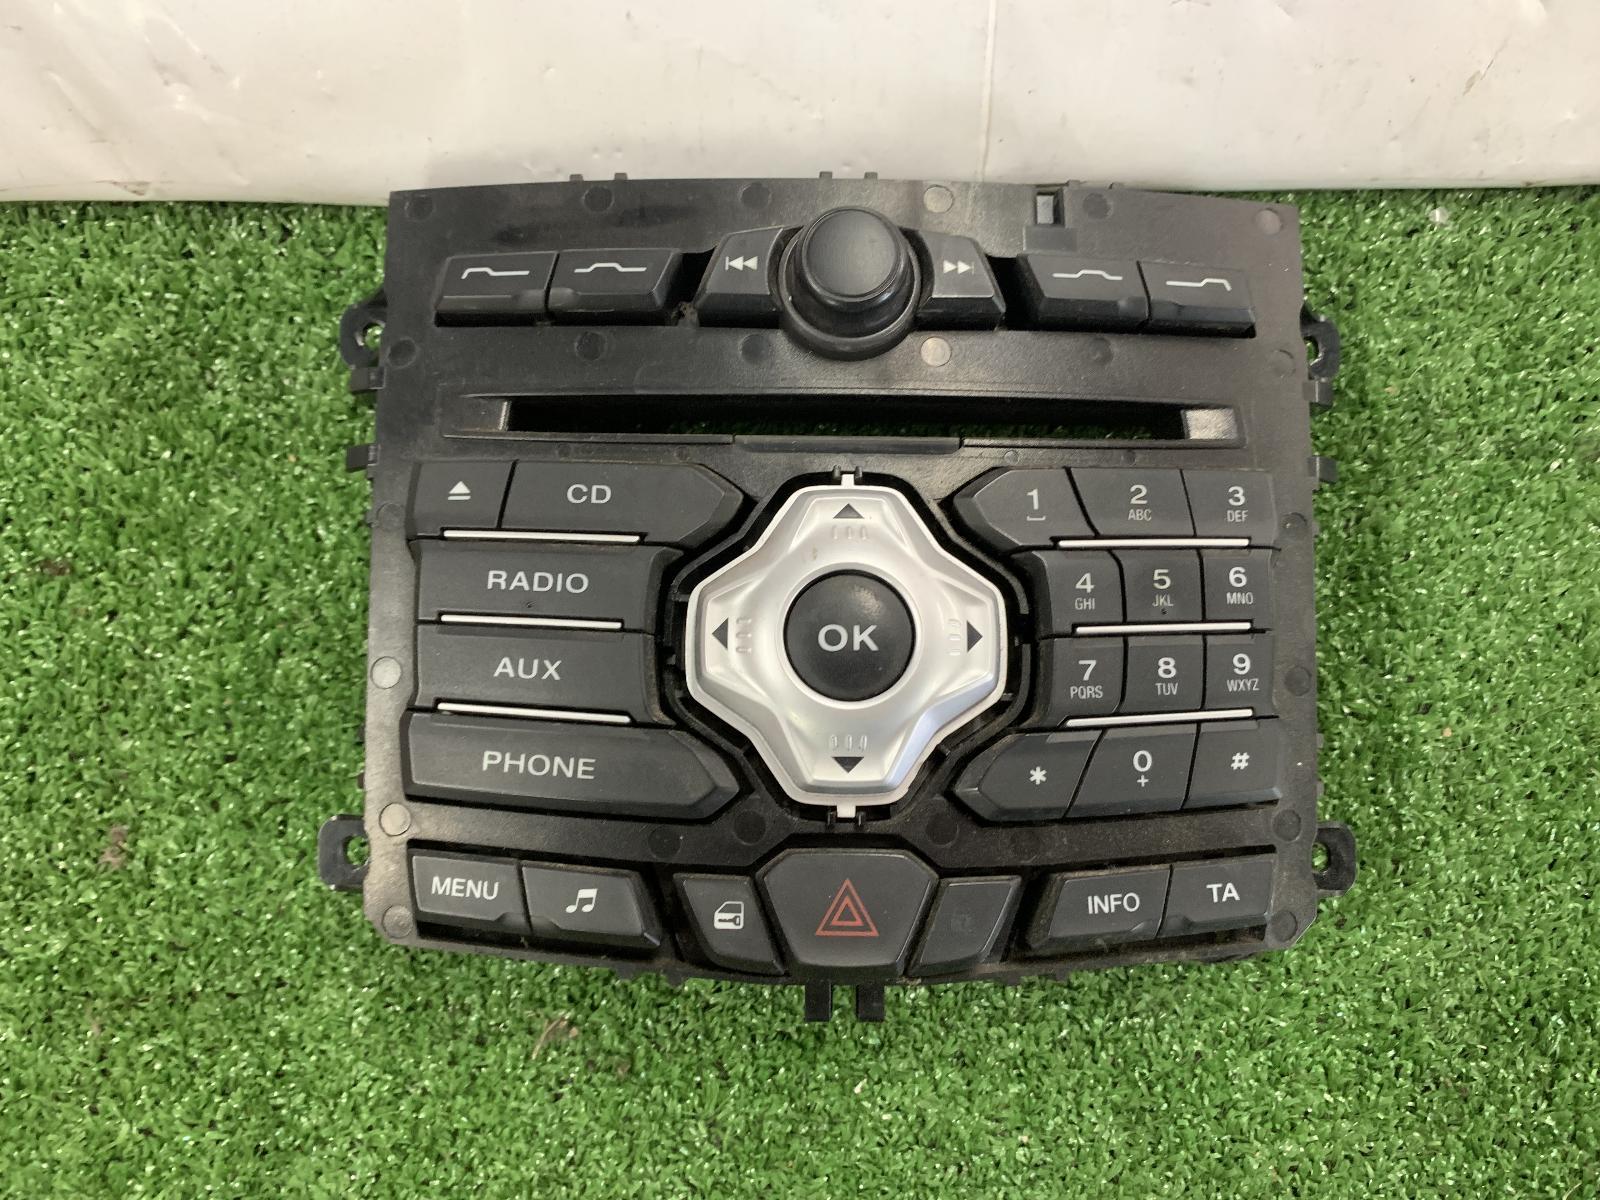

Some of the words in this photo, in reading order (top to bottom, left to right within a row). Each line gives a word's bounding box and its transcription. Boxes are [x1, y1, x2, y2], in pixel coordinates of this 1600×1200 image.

[566, 483, 612, 504] CD
[1026, 488, 1039, 510] 1
[1130, 484, 1148, 505] 2
[1228, 485, 1246, 506] 3
[1127, 508, 1152, 522] ABC
[1226, 509, 1249, 523] DEF
[487, 570, 589, 594] RADIO
[1075, 572, 1095, 593] 4
[1153, 568, 1172, 590] 5
[1228, 566, 1248, 588] 6
[1074, 597, 1096, 611] GHI
[1152, 594, 1174, 607] JKL
[1226, 591, 1254, 605] MNO
[817, 623, 879, 652] OK
[493, 656, 562, 681] AUX
[1078, 659, 1097, 681] 7
[1157, 657, 1177, 679] 8
[1232, 653, 1251, 675] 9
[1069, 685, 1104, 700] PQRS
[1155, 682, 1179, 696] TUV
[1226, 678, 1260, 692] WXYZ
[482, 750, 596, 780] PHONE
[1132, 749, 1153, 772] 0
[431, 875, 499, 901] MENU
[1206, 882, 1241, 903] TA
[1087, 892, 1140, 915] INFO
